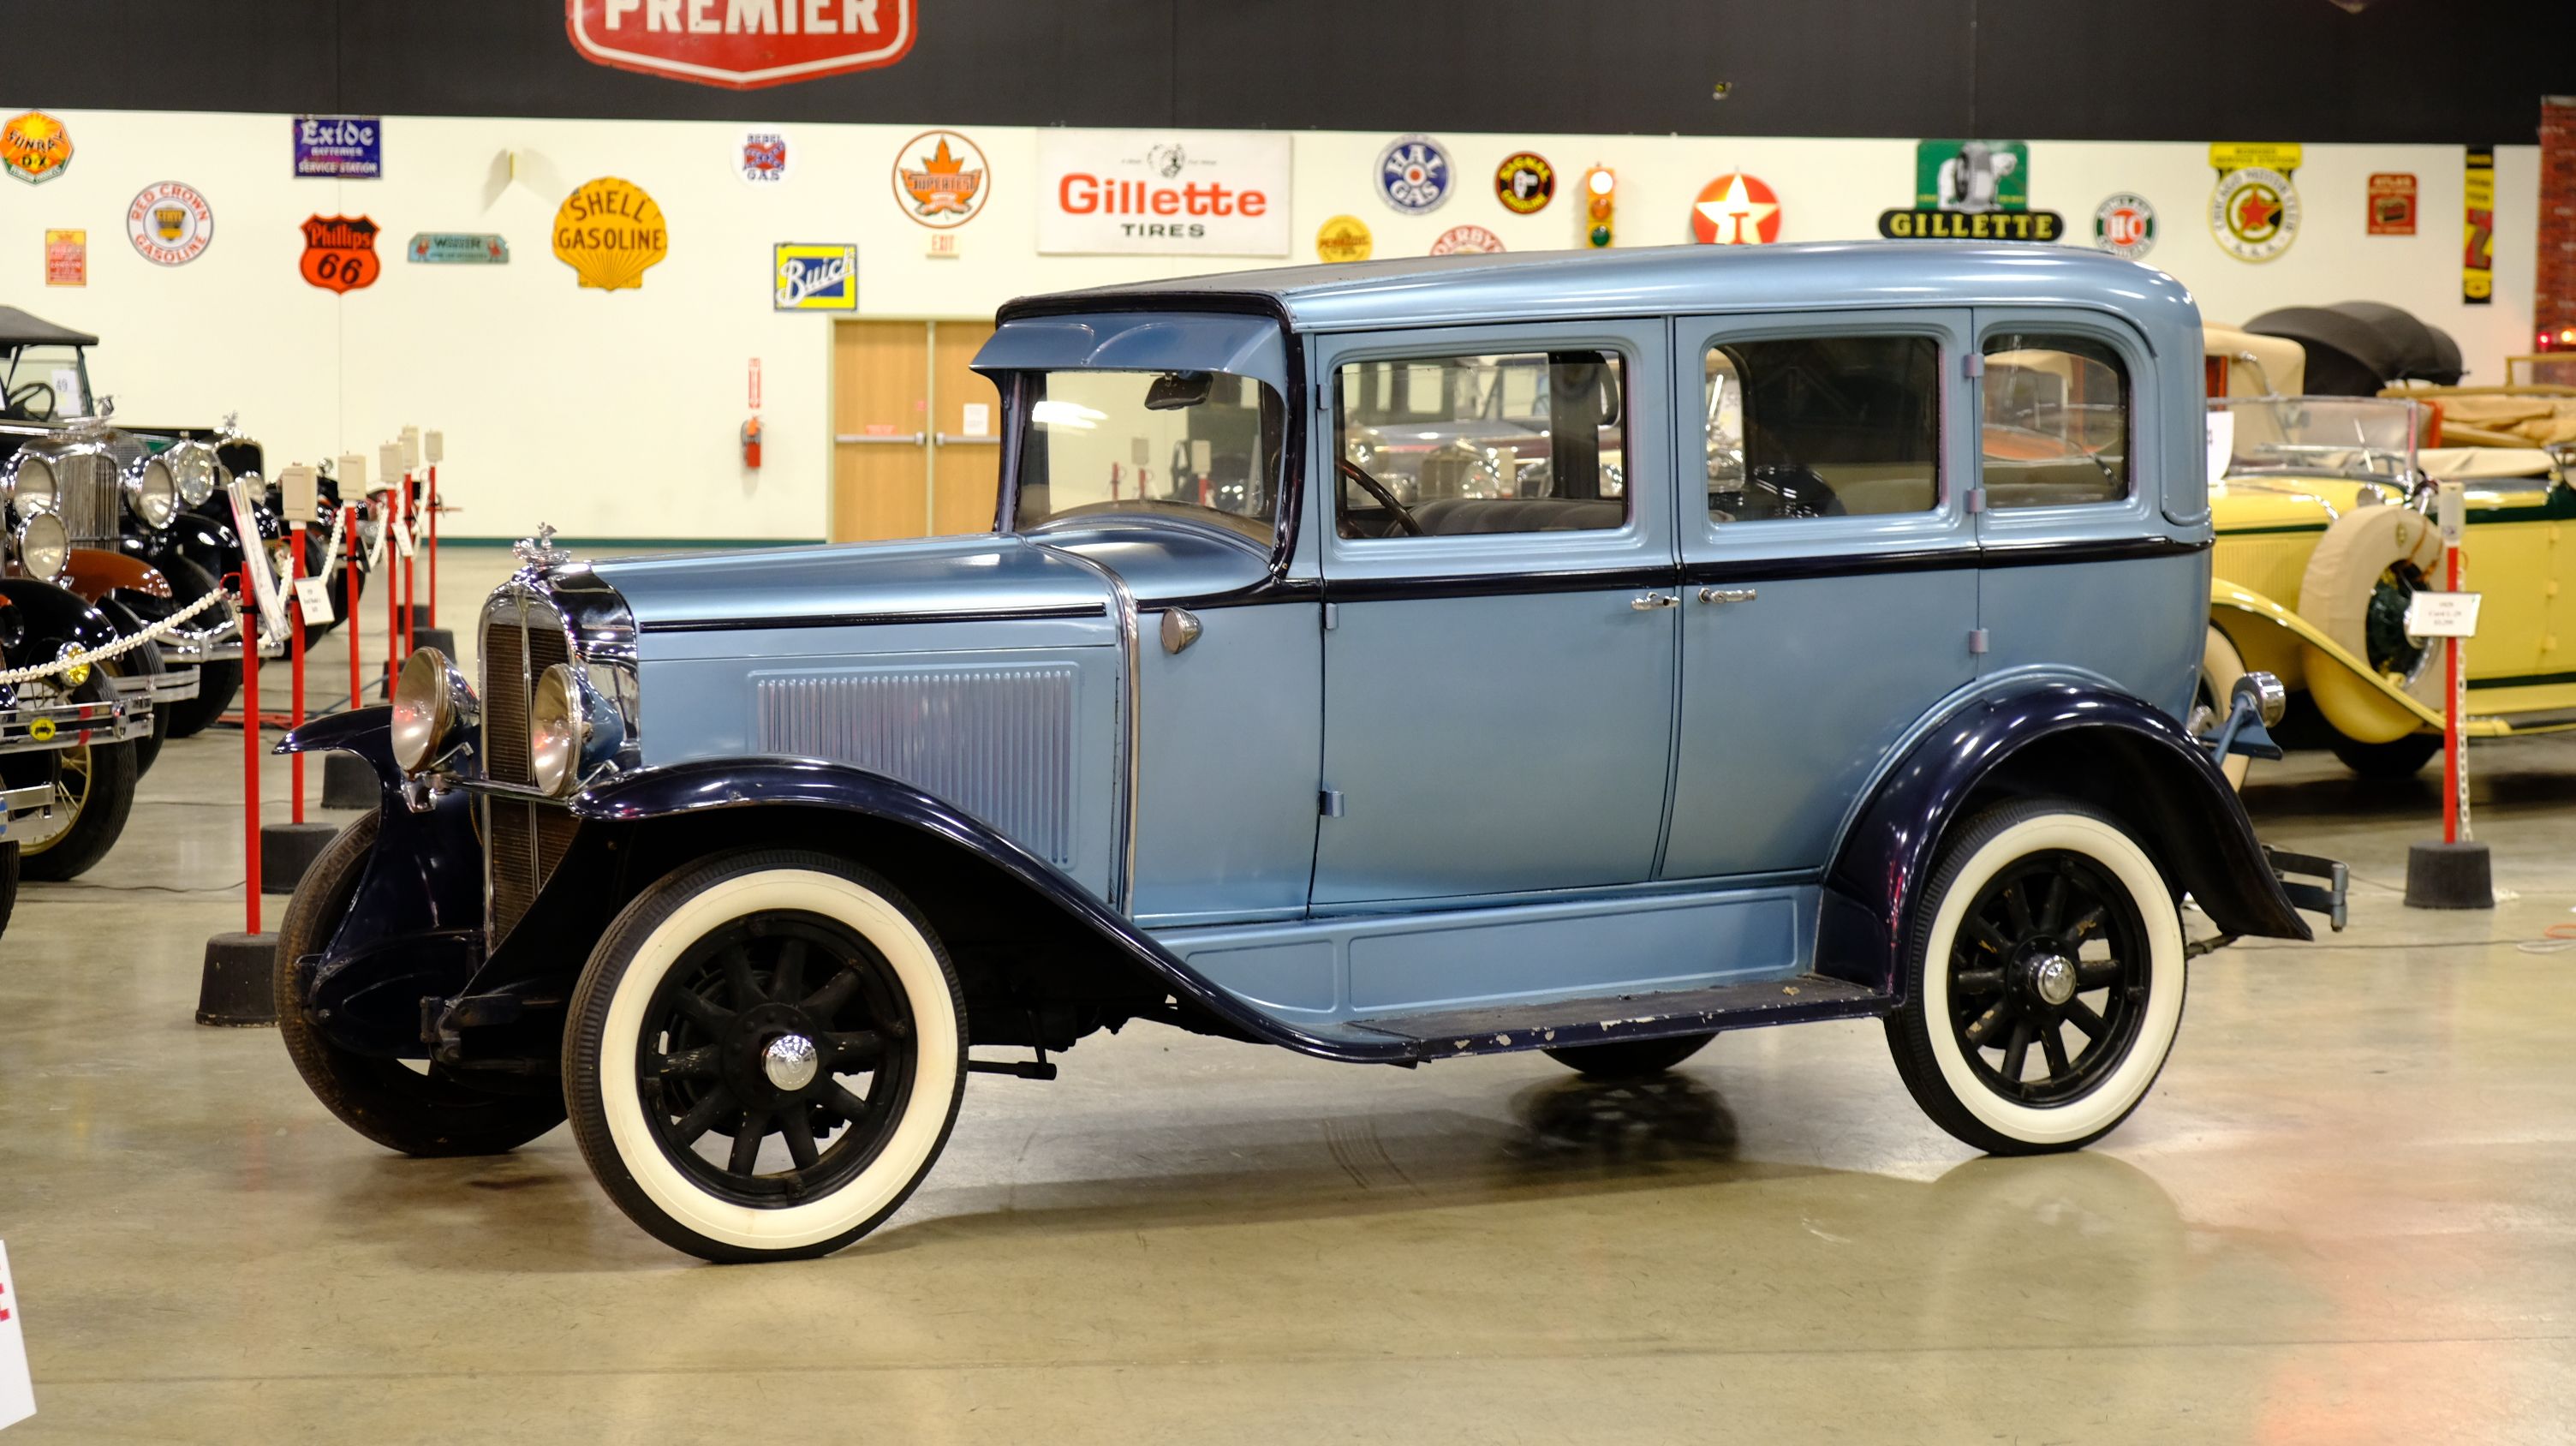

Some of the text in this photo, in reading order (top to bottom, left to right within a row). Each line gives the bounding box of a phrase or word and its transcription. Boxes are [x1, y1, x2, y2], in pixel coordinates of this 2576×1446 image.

[604, 0, 880, 35] PREMIER
[8, 128, 66, 152] SUNRAY
[301, 118, 375, 146] Exide
[311, 146, 364, 157] BATTERIES
[298, 160, 378, 174] SERVICE STATION
[747, 170, 780, 181] GAS
[131, 183, 209, 222] RED CROWN
[569, 189, 648, 224] SHELL
[1058, 172, 1267, 217] Gillette
[1390, 179, 1440, 206] GAS
[307, 222, 373, 251] Phillips
[558, 227, 665, 251] GASOLINE
[1120, 223, 1206, 238] TIRES
[1728, 212, 1750, 244] T
[1889, 213, 2054, 239] GILLETTE
[135, 234, 207, 265] GASOLINE
[931, 234, 955, 252] EXIT
[318, 253, 363, 285] 66
[776, 245, 856, 307] Buick
